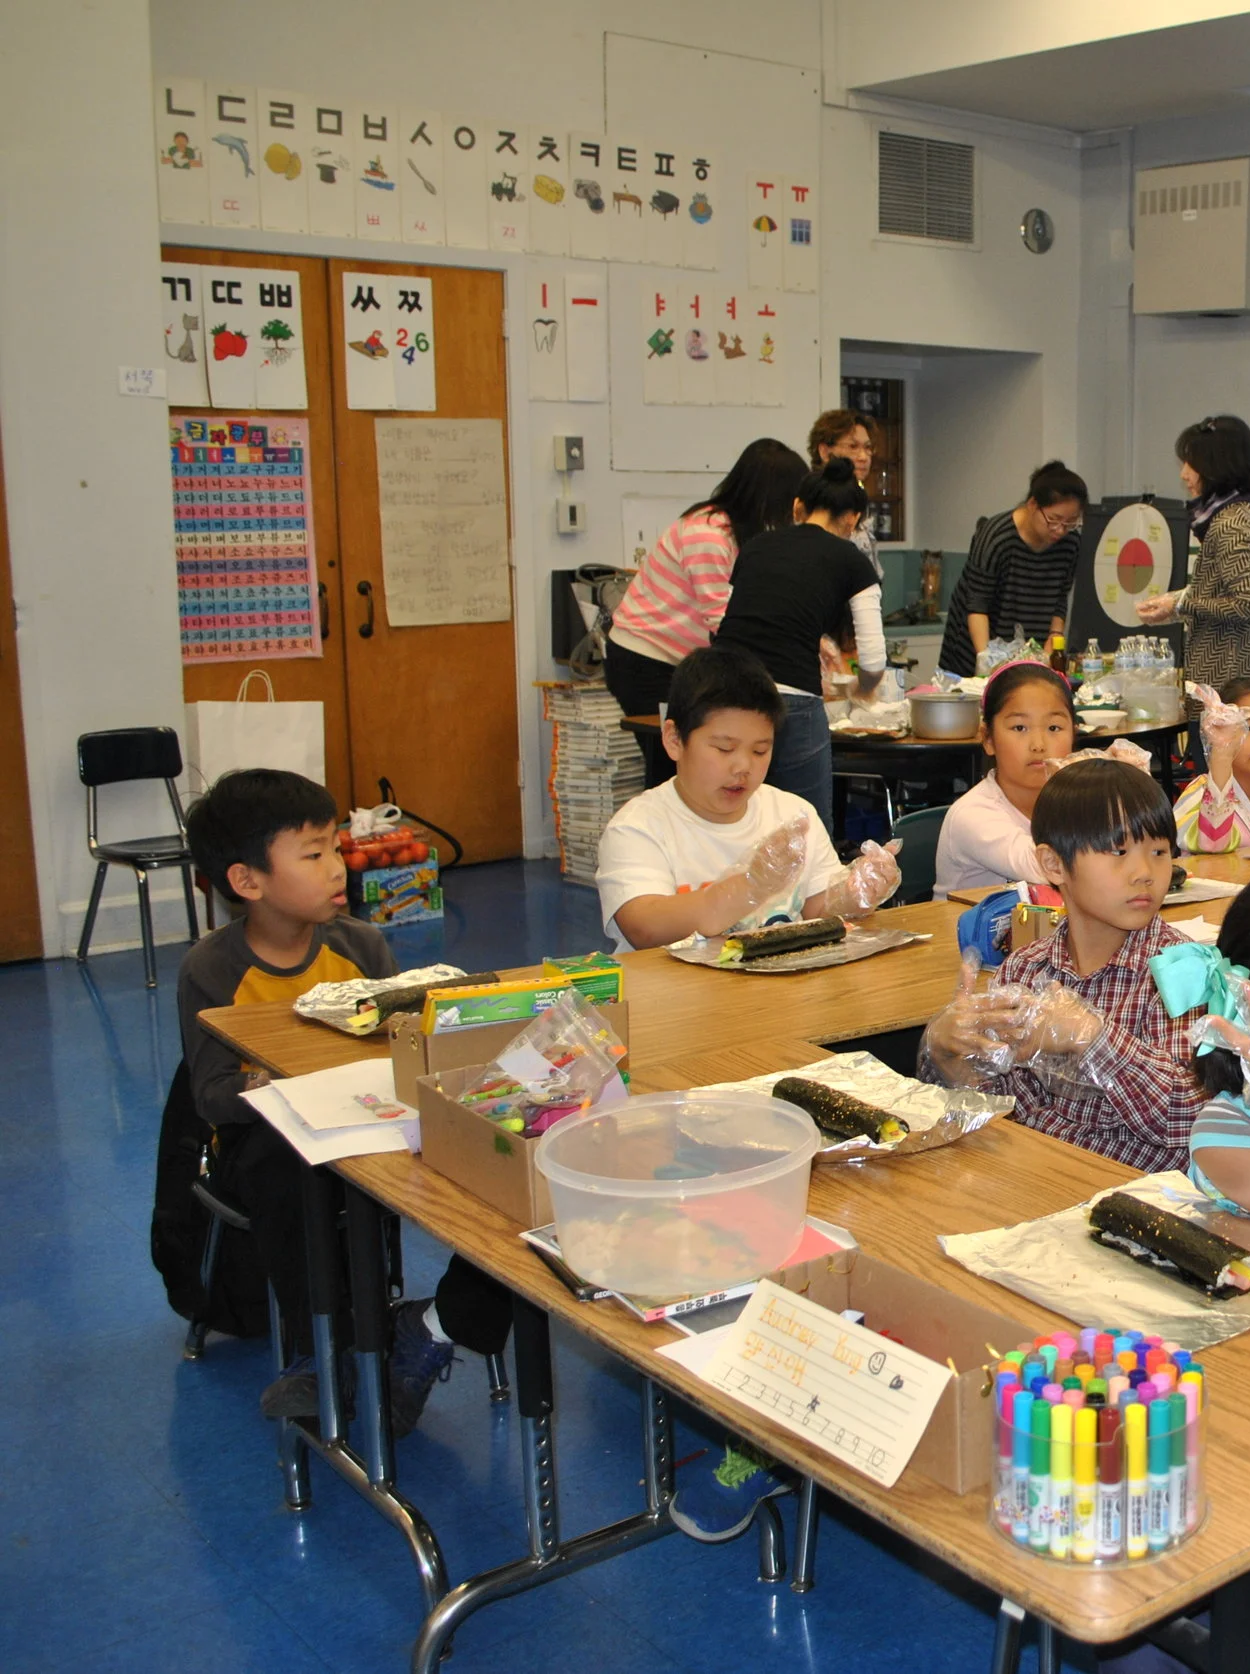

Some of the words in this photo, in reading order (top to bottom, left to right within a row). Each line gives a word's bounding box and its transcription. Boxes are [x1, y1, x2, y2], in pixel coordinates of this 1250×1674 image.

[396, 328, 408, 347] 2
[414, 332, 429, 353] 6
[401, 345, 415, 364] 4
[759, 1297, 820, 1350] Audrey
[723, 1366, 733, 1380] 1
[737, 1375, 750, 1391] 2
[755, 1384, 766, 1399] 3
[772, 1392, 781, 1408] 4
[785, 1402, 795, 1417] 5
[802, 1412, 812, 1426] 6
[819, 1420, 830, 1434] 7
[834, 1428, 845, 1445] 8
[852, 1436, 860, 1451] 9
[867, 1446, 886, 1468] 10
